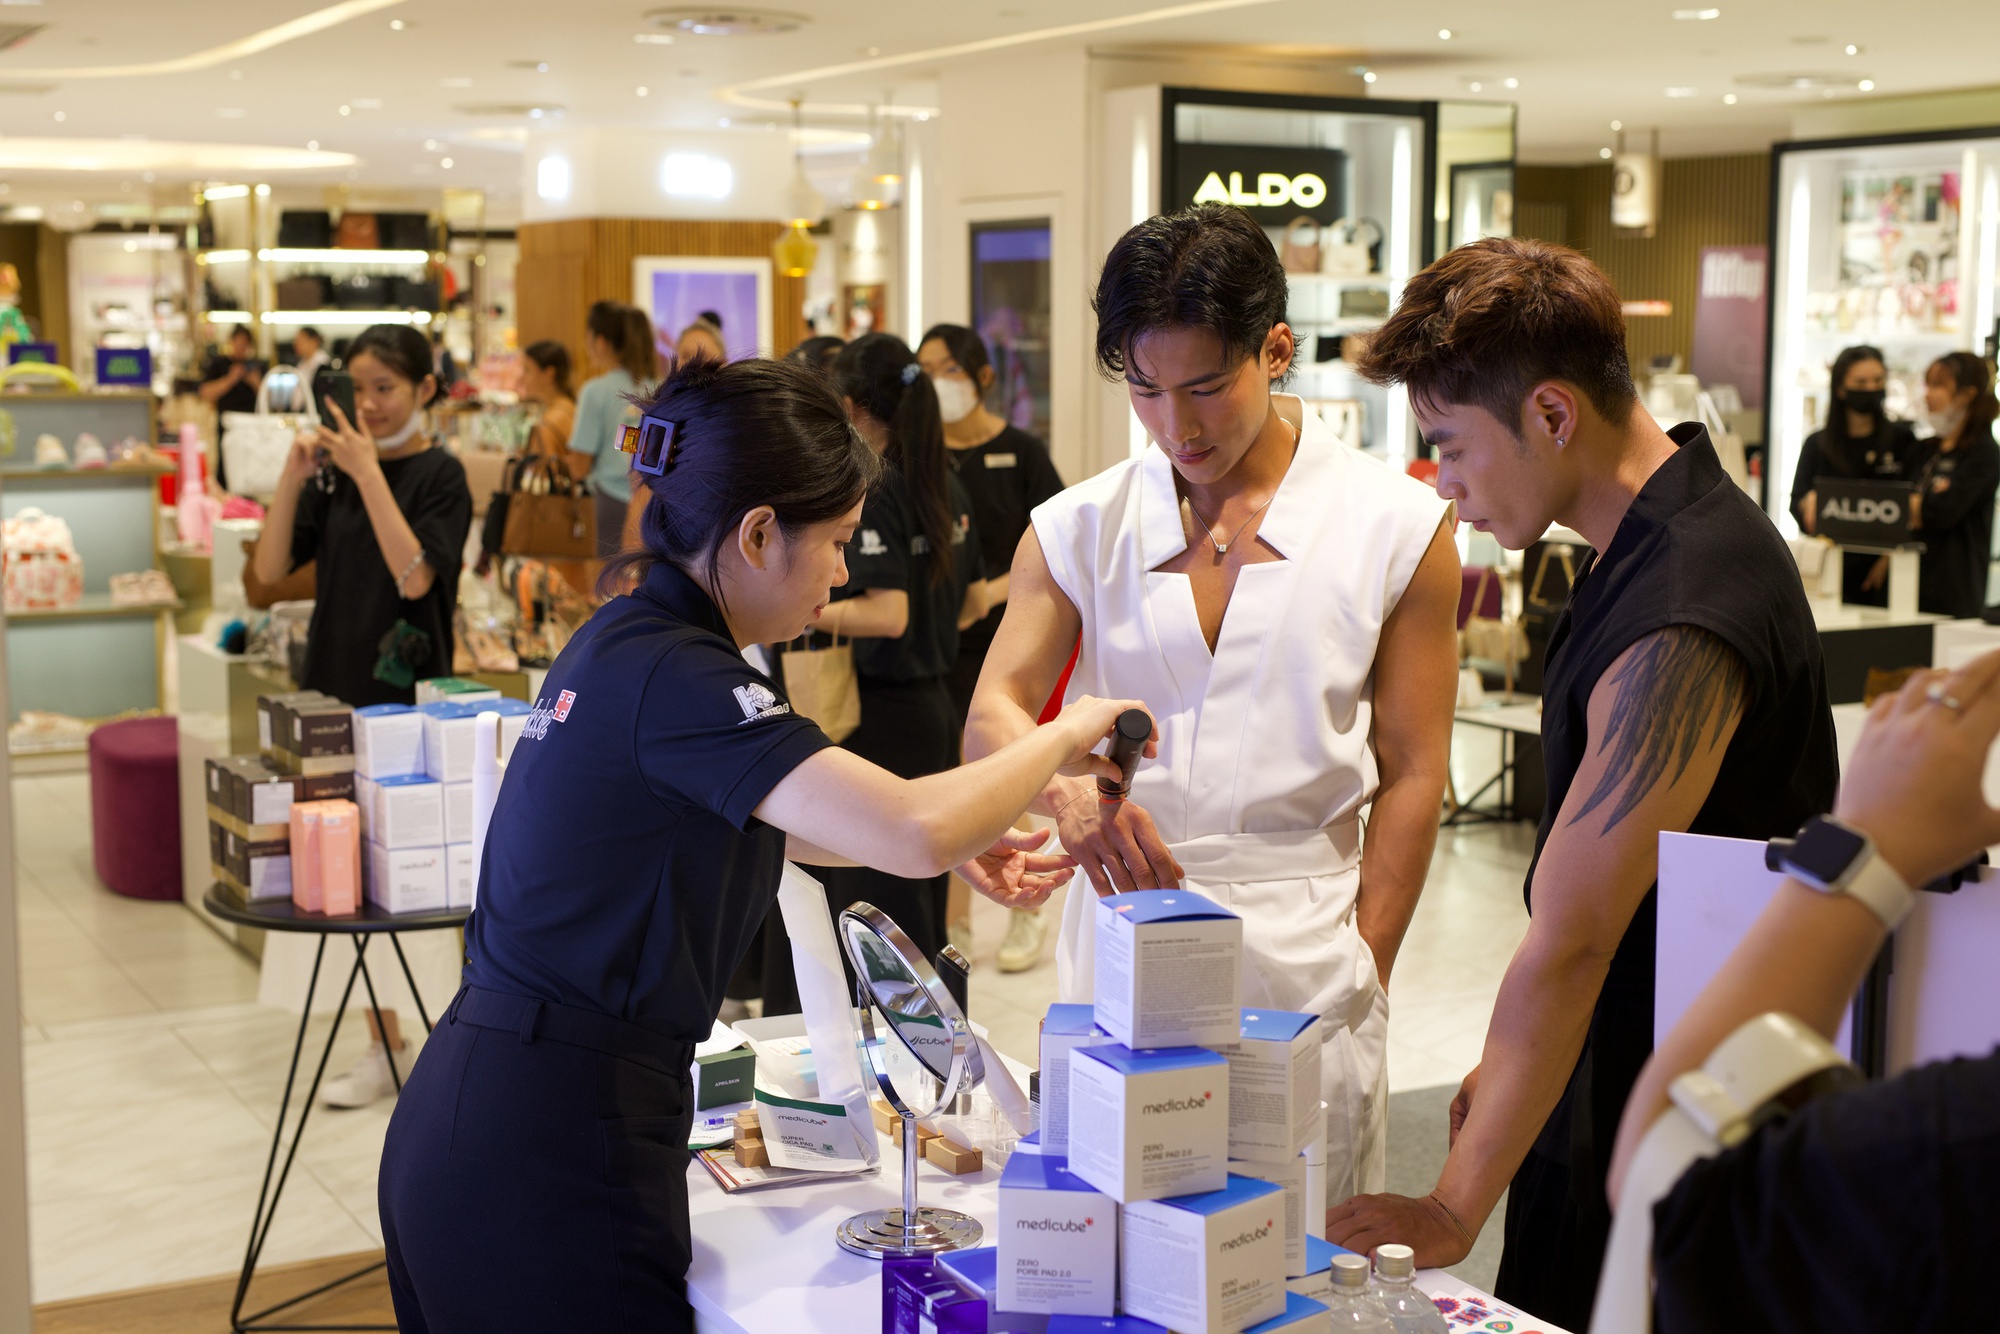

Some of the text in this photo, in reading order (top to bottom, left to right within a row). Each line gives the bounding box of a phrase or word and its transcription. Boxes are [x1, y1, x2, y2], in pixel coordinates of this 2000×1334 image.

[1193, 171, 1327, 208] ALDO
[1821, 497, 1901, 524] ALDO
[1143, 1097, 1205, 1114] medicube
[778, 1115, 823, 1125] medicube
[1143, 1143, 1163, 1153] ZERO
[1017, 1218, 1087, 1232] medicube
[1220, 1227, 1268, 1252] medicube
[1017, 1259, 1039, 1267] ZERO
[1017, 1267, 1072, 1278] PORE PAD 2.0
